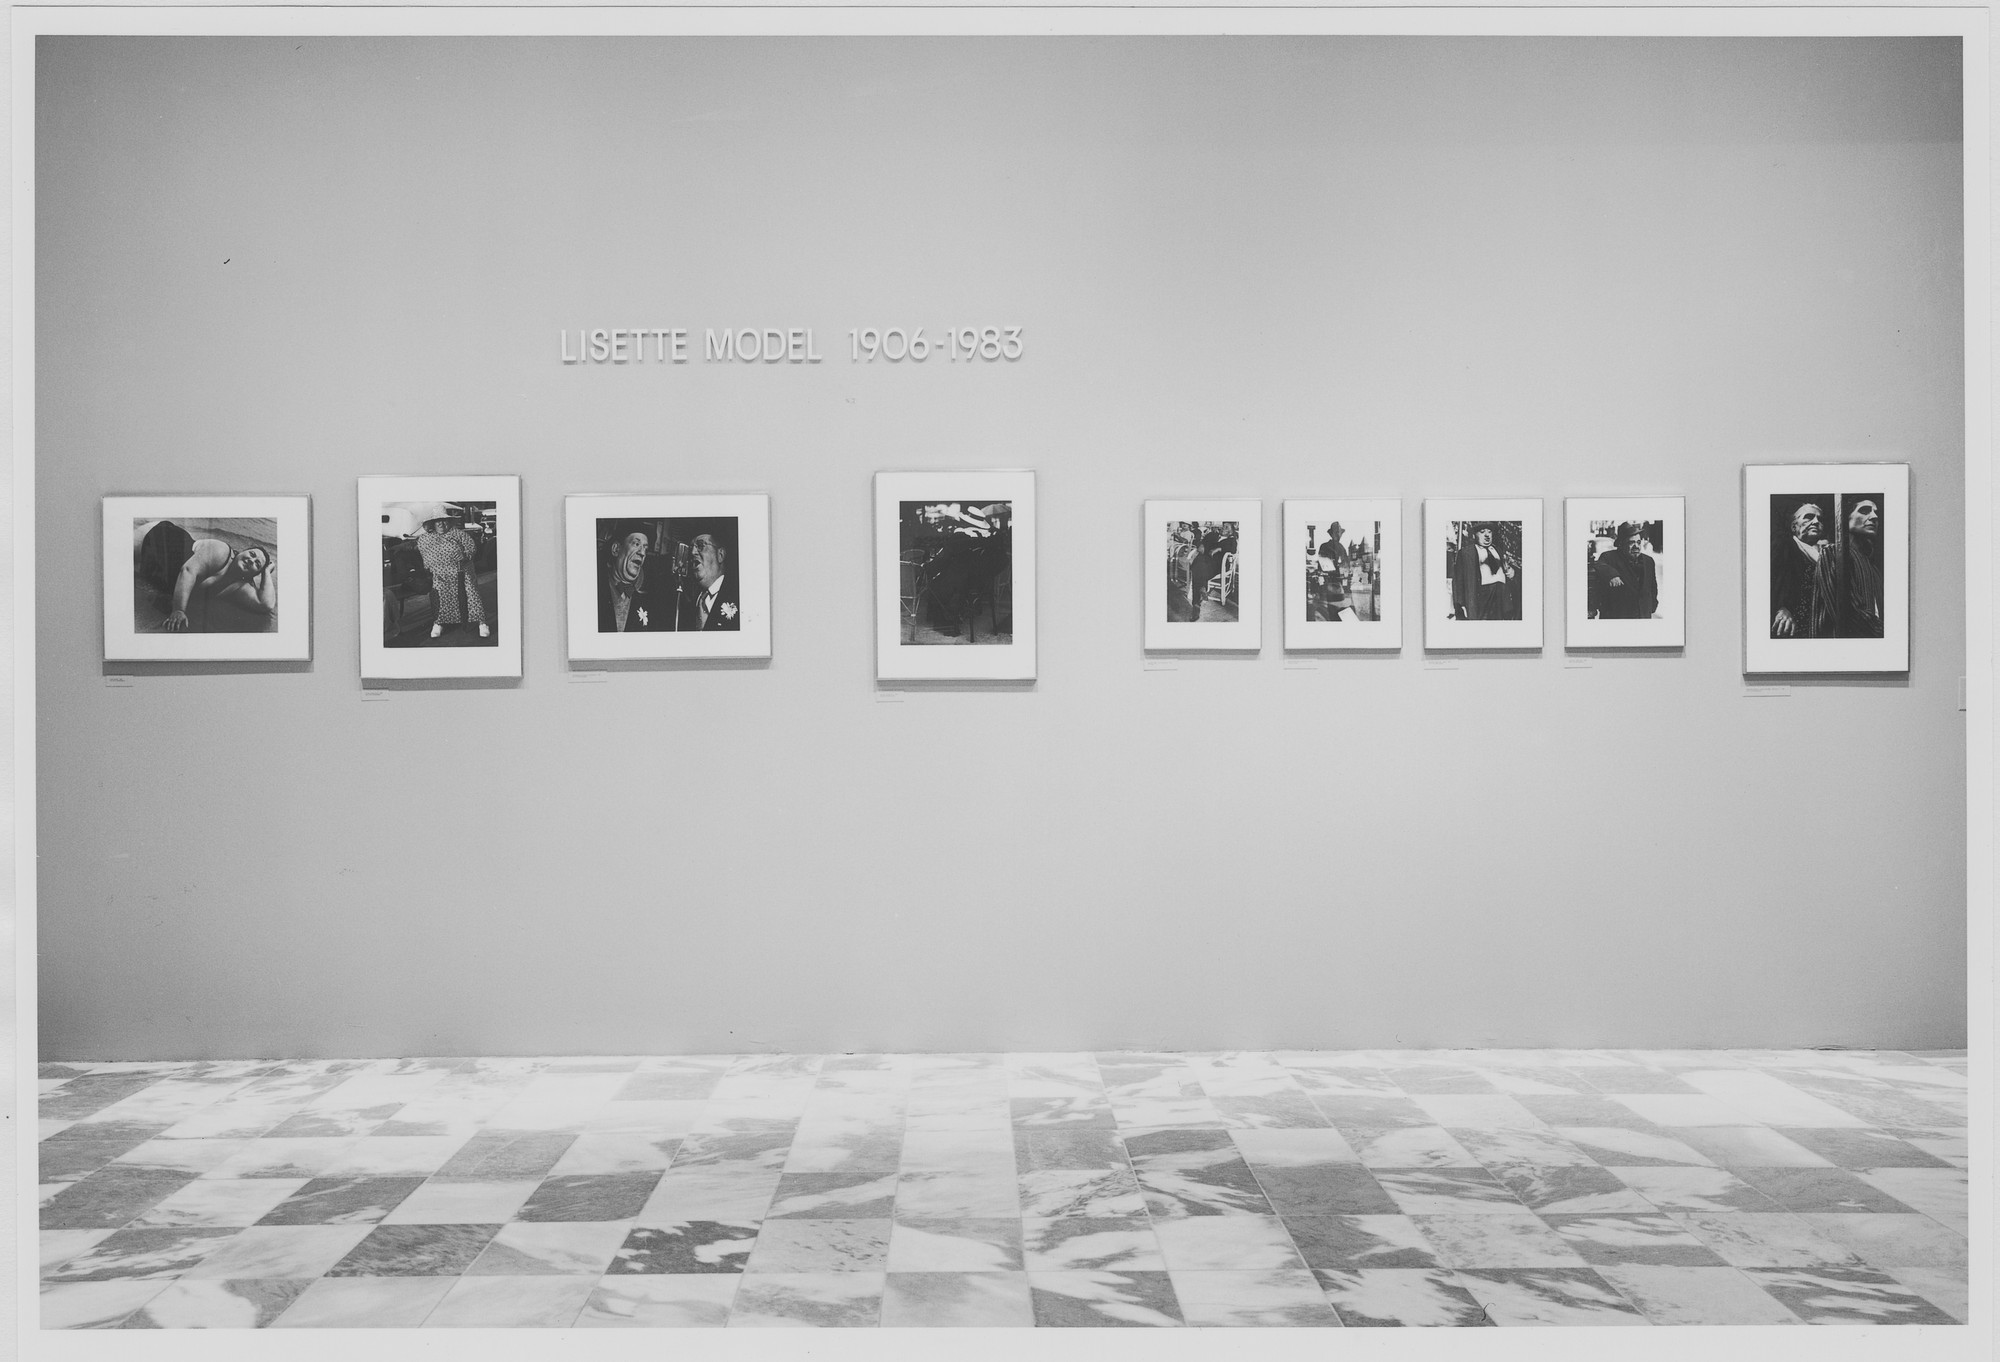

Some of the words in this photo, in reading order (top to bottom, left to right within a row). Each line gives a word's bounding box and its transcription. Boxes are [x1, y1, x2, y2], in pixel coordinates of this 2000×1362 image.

[560, 328, 688, 363] LISETTE
[705, 327, 823, 362] MODEL
[849, 326, 1024, 362] 1906-1983
